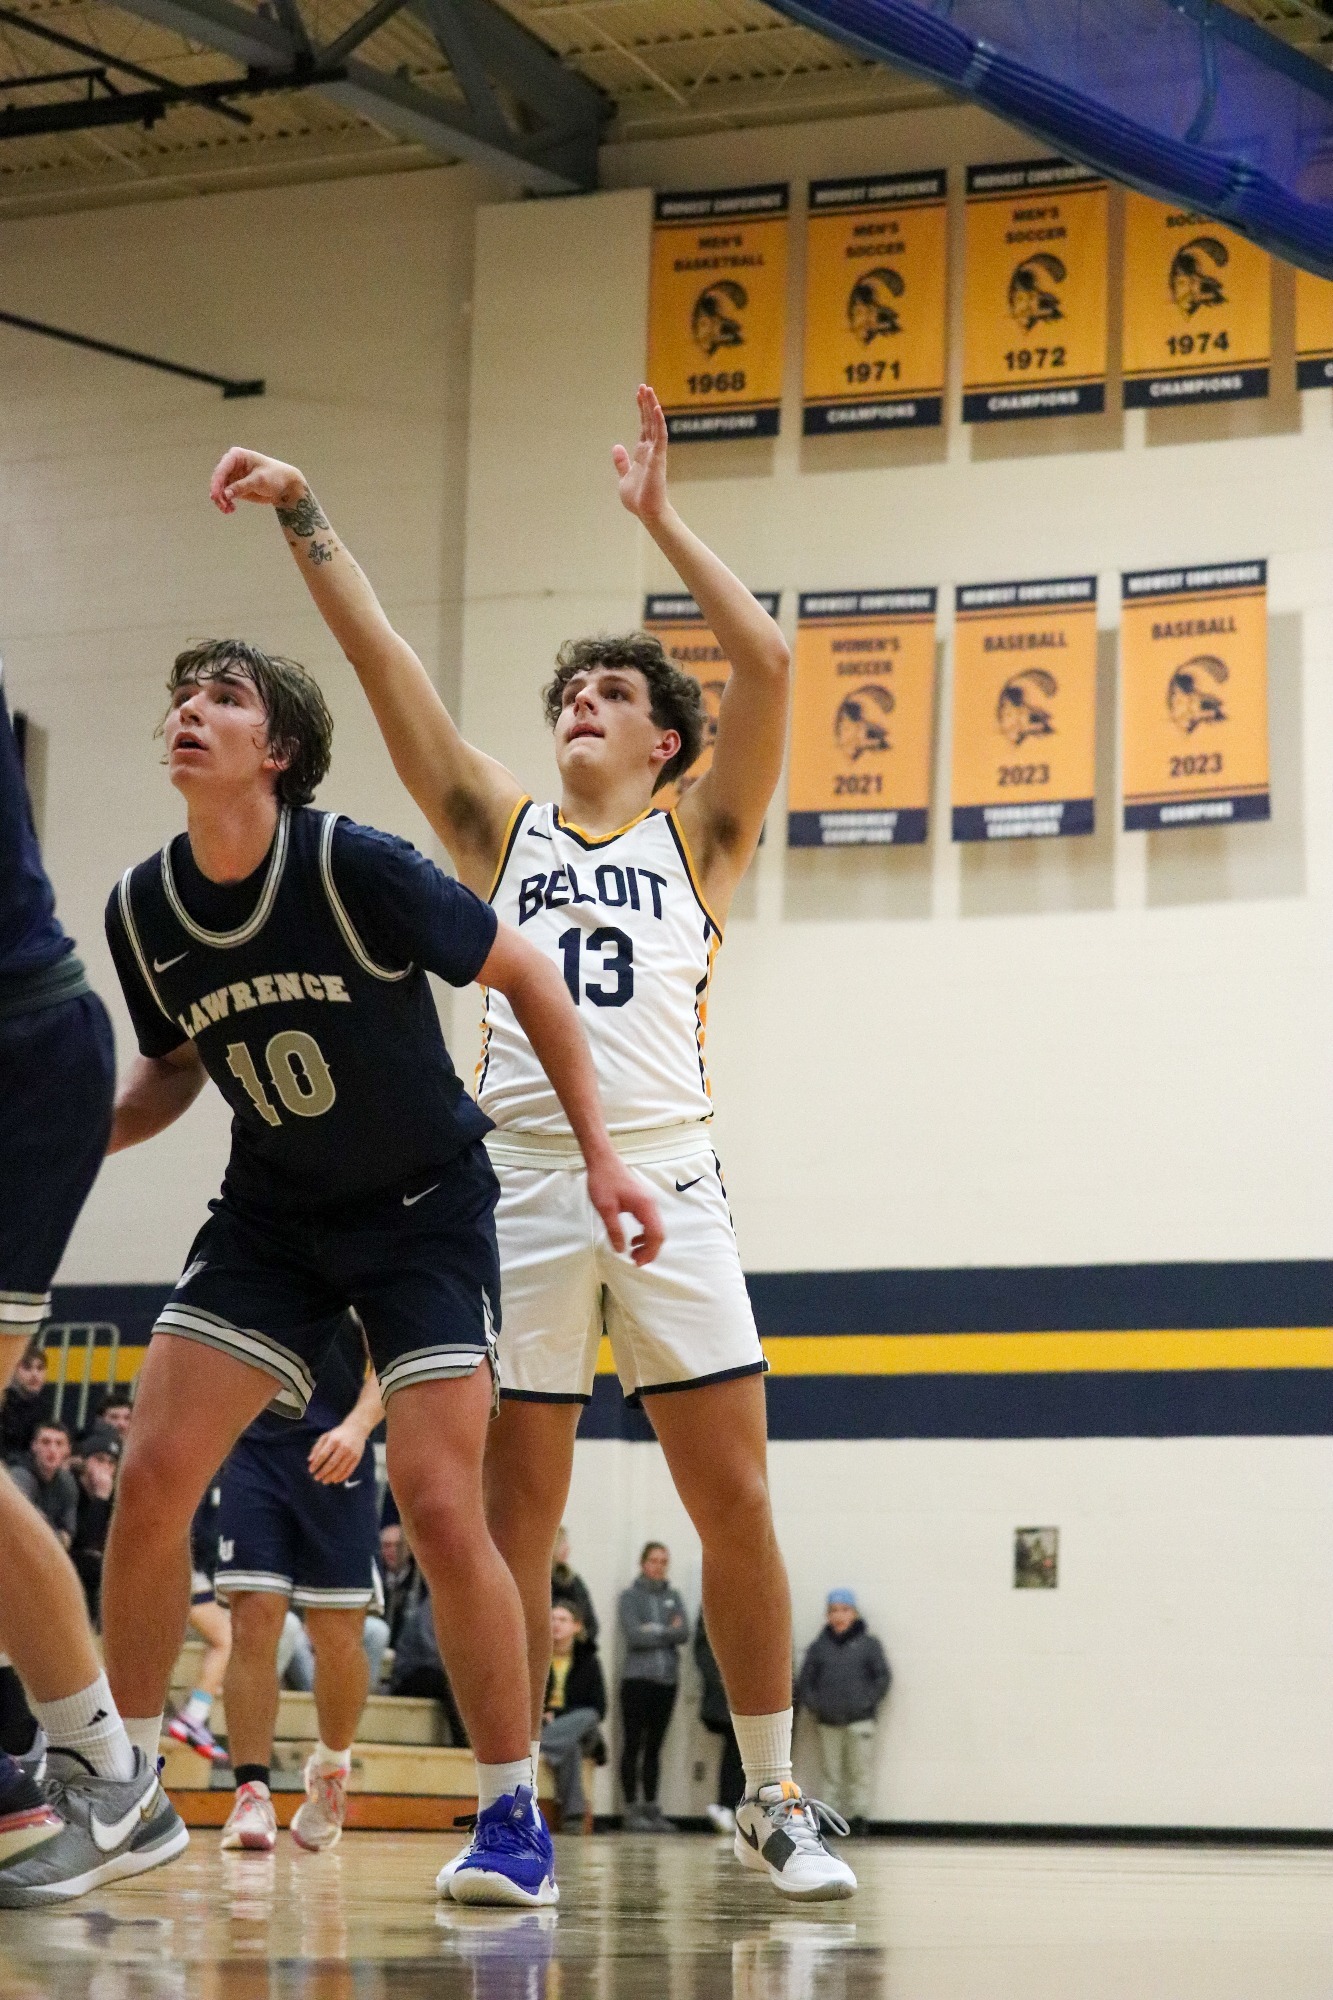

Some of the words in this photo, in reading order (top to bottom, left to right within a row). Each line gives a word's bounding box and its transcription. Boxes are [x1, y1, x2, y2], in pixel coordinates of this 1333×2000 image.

[674, 253, 764, 272] BASKETBALL
[1167, 331, 1230, 356] 1974
[1004, 347, 1066, 371] 1972
[687, 371, 746, 394] 1968
[845, 361, 901, 383] 1971
[1150, 375, 1243, 397] CHAMPIONS
[988, 390, 1079, 411] CHAMPIONS
[670, 415, 756, 433] CHAMPIONS
[827, 403, 916, 423] CHAMPIONS
[1151, 616, 1237, 640] BASEBALL
[984, 631, 1067, 652] BASEBALL
[997, 764, 1051, 786] 2023
[1170, 753, 1223, 777] 2023
[834, 774, 883, 795] 2021
[519, 863, 668, 926] BELOIT
[559, 927, 634, 1007] 13
[177, 972, 352, 1039] LAWRENCE
[226, 1030, 336, 1126] 10
